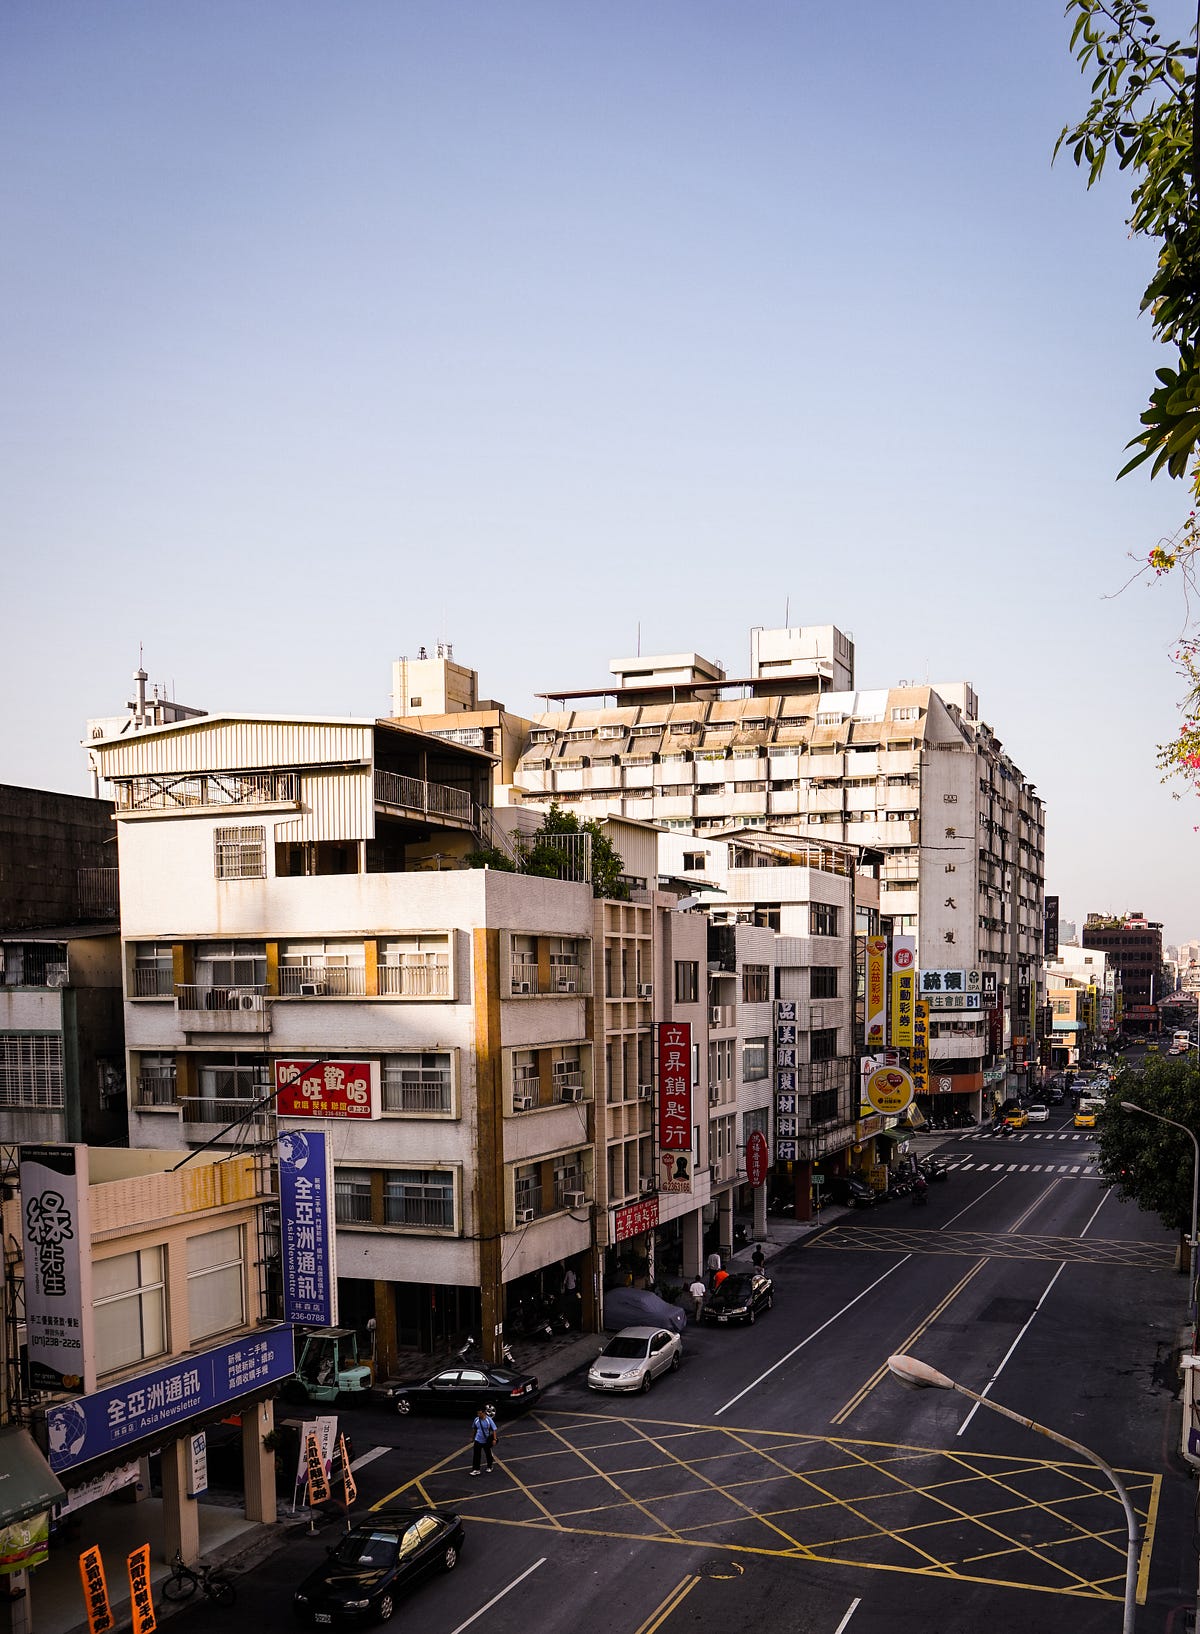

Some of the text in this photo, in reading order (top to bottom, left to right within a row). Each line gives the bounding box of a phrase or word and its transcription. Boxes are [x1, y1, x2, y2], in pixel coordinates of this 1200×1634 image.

[871, 961, 881, 1005] 公益彩券
[899, 977, 911, 1027] 運動彩券
[923, 972, 962, 990] 統領
[924, 996, 963, 1006] 養生會館
[967, 996, 978, 1007] B1
[664, 1027, 687, 1144] 立昇鎖匙行
[779, 1002, 795, 1159] 品美服裝材料行
[287, 1219, 296, 1298] Asia Newsletter
[294, 1176, 317, 1299] 全亞洲通訊
[291, 1312, 325, 1322] 236-0788
[107, 1369, 200, 1427] 全亞洲通訊
[140, 1397, 200, 1428] Asia Newsletter
